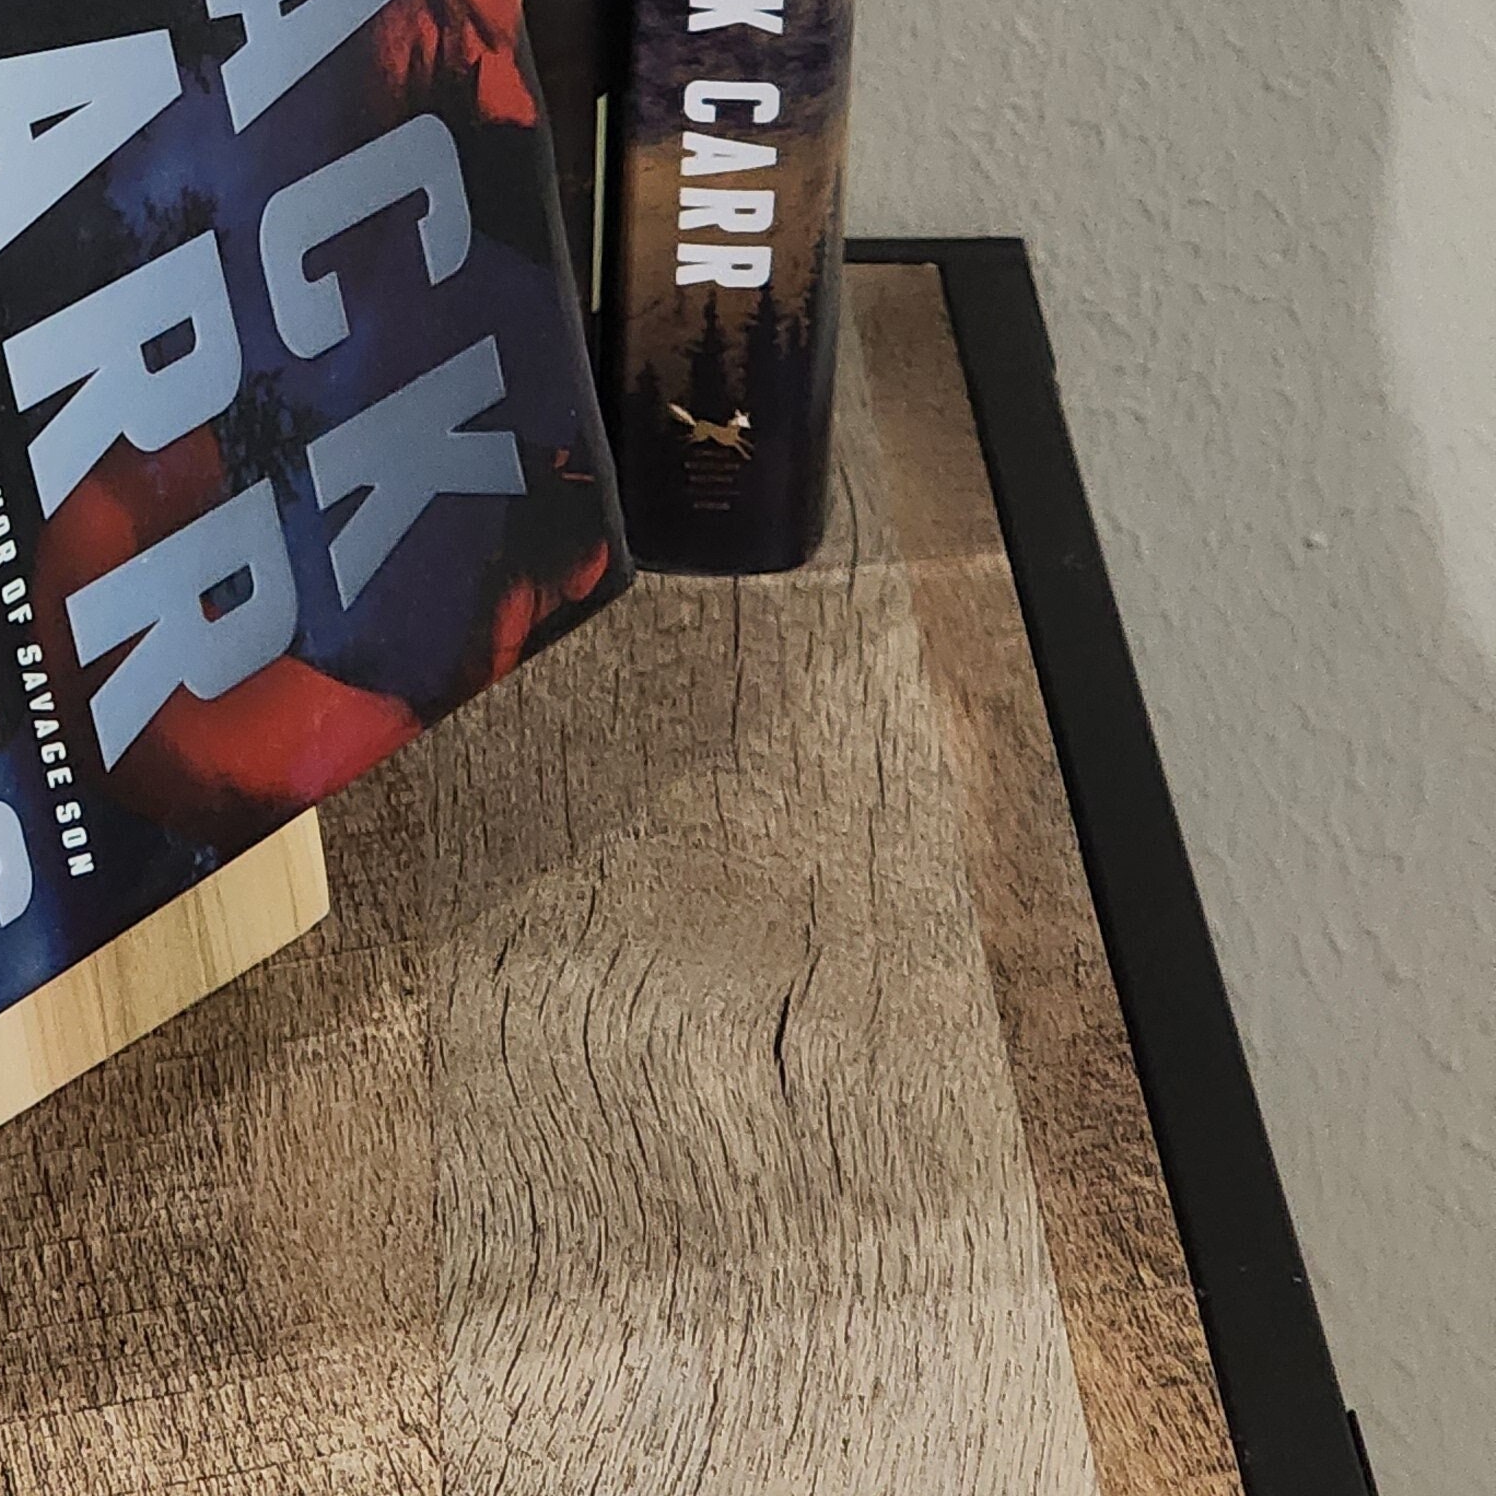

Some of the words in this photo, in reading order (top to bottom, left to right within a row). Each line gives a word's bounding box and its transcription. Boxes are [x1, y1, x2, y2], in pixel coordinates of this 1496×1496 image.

[676, 81, 779, 287] CARR
[2, 578, 32, 623] OF
[17, 645, 72, 788] SAVAGE
[56, 802, 94, 875] SON
